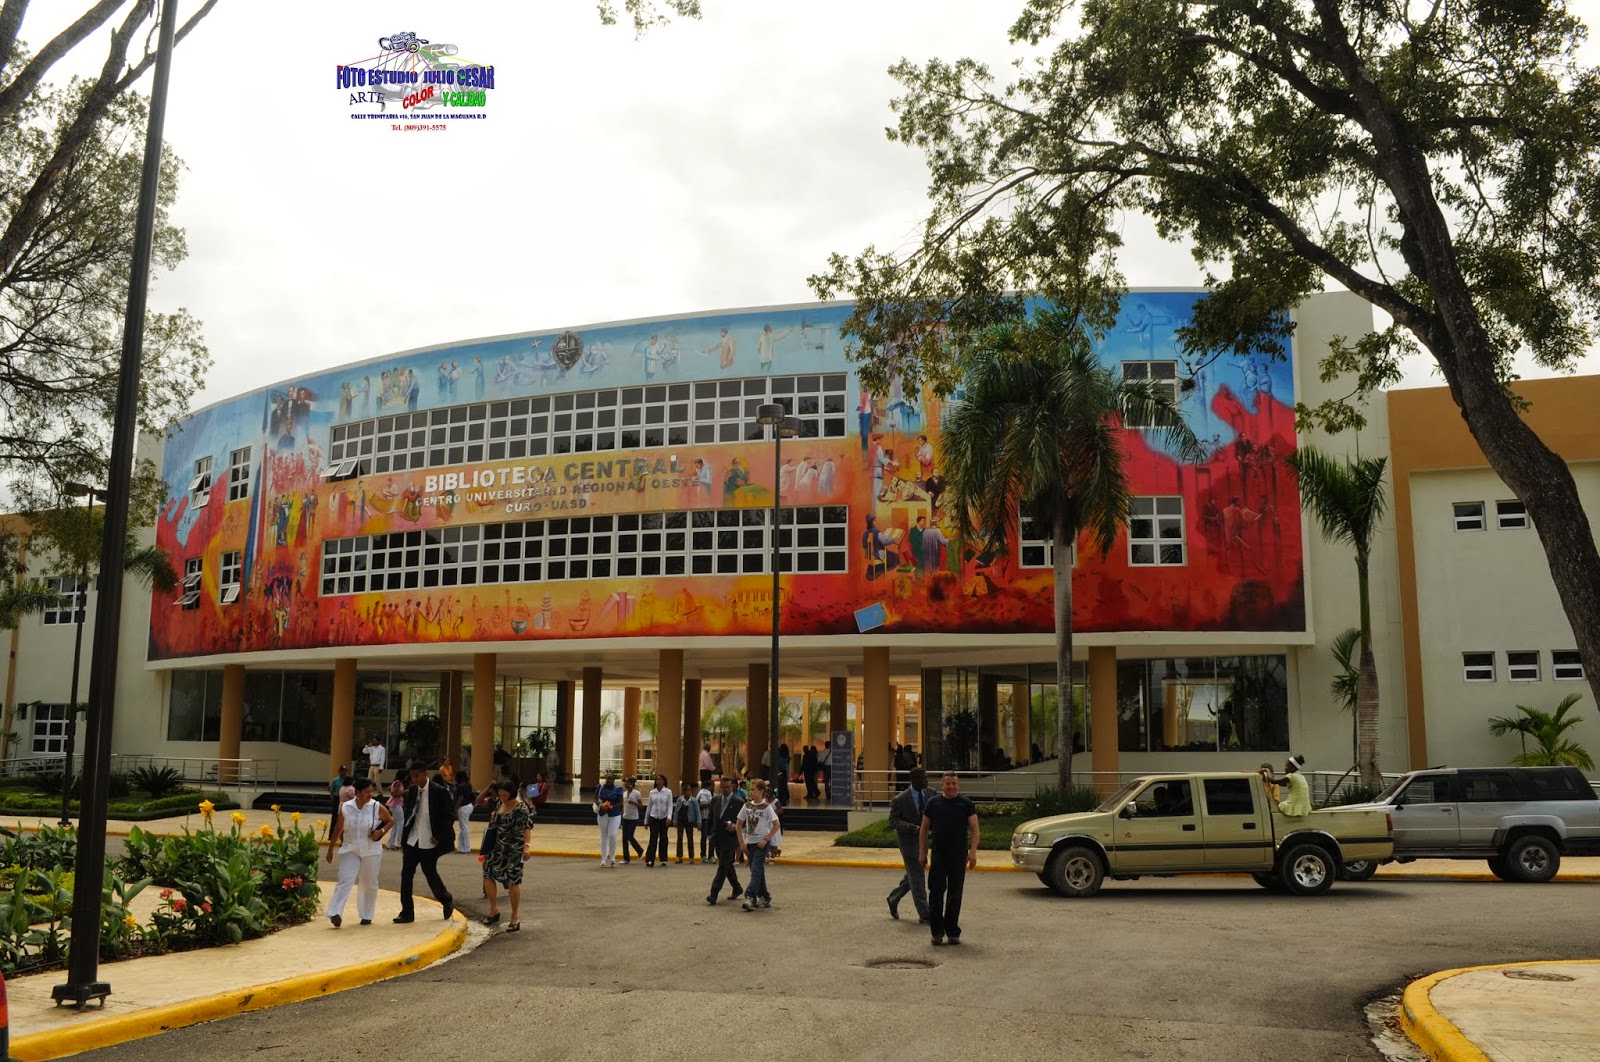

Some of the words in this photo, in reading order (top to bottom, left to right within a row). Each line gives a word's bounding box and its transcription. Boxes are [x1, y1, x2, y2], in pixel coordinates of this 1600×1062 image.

[425, 464, 557, 493] BIBLIOTECA
[563, 454, 685, 482] CENTRAL
[415, 494, 461, 507] CENTRO
[466, 485, 567, 502] UNIVERSITARIO
[572, 480, 645, 495] REGIONAL
[651, 476, 700, 489] OESTE
